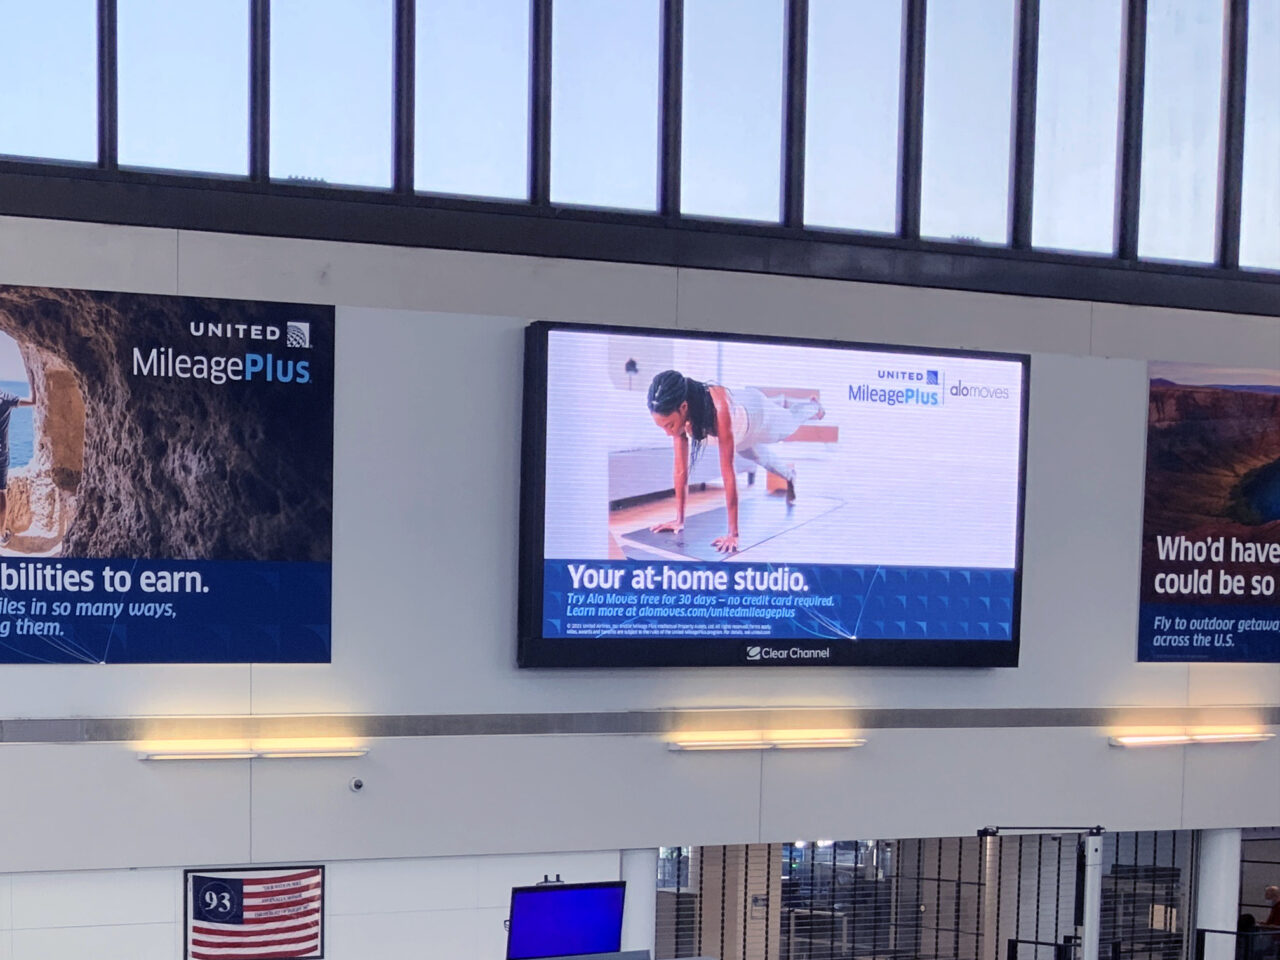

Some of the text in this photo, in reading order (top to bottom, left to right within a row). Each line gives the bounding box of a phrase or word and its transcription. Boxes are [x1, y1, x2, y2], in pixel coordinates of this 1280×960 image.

[190, 321, 280, 341] UNITED
[132, 347, 311, 385] MileagePlus
[877, 370, 924, 381] UNITED
[848, 384, 938, 406] MileagePlus
[1156, 535, 1280, 564] Who'd have
[102, 566, 132, 592] to
[140, 570, 209, 594] earn.
[567, 564, 809, 592] Your at-home studio.
[1154, 569, 1275, 595] could be so
[30, 598, 47, 615] in
[52, 602, 71, 616] so
[75, 602, 124, 619] many
[128, 602, 177, 619] ways,
[567, 593, 585, 605] Try
[586, 593, 604, 604] Alo
[606, 593, 638, 605] Moves
[640, 593, 660, 605] free
[661, 593, 677, 605] for
[678, 594, 691, 605] 30
[693, 594, 717, 606] days
[727, 596, 740, 606] no
[742, 595, 769, 606] credit
[770, 595, 793, 606] card
[794, 596, 835, 608] required.
[566, 606, 596, 617] Learn
[597, 607, 623, 617] more
[625, 606, 637, 617] at
[16, 618, 65, 636] them.
[1153, 616, 1280, 633] Fly to outdoor getawa
[1153, 633, 1235, 647] across the U.S.
[761, 647, 830, 659] Clear Channel
[204, 890, 231, 912] 93
